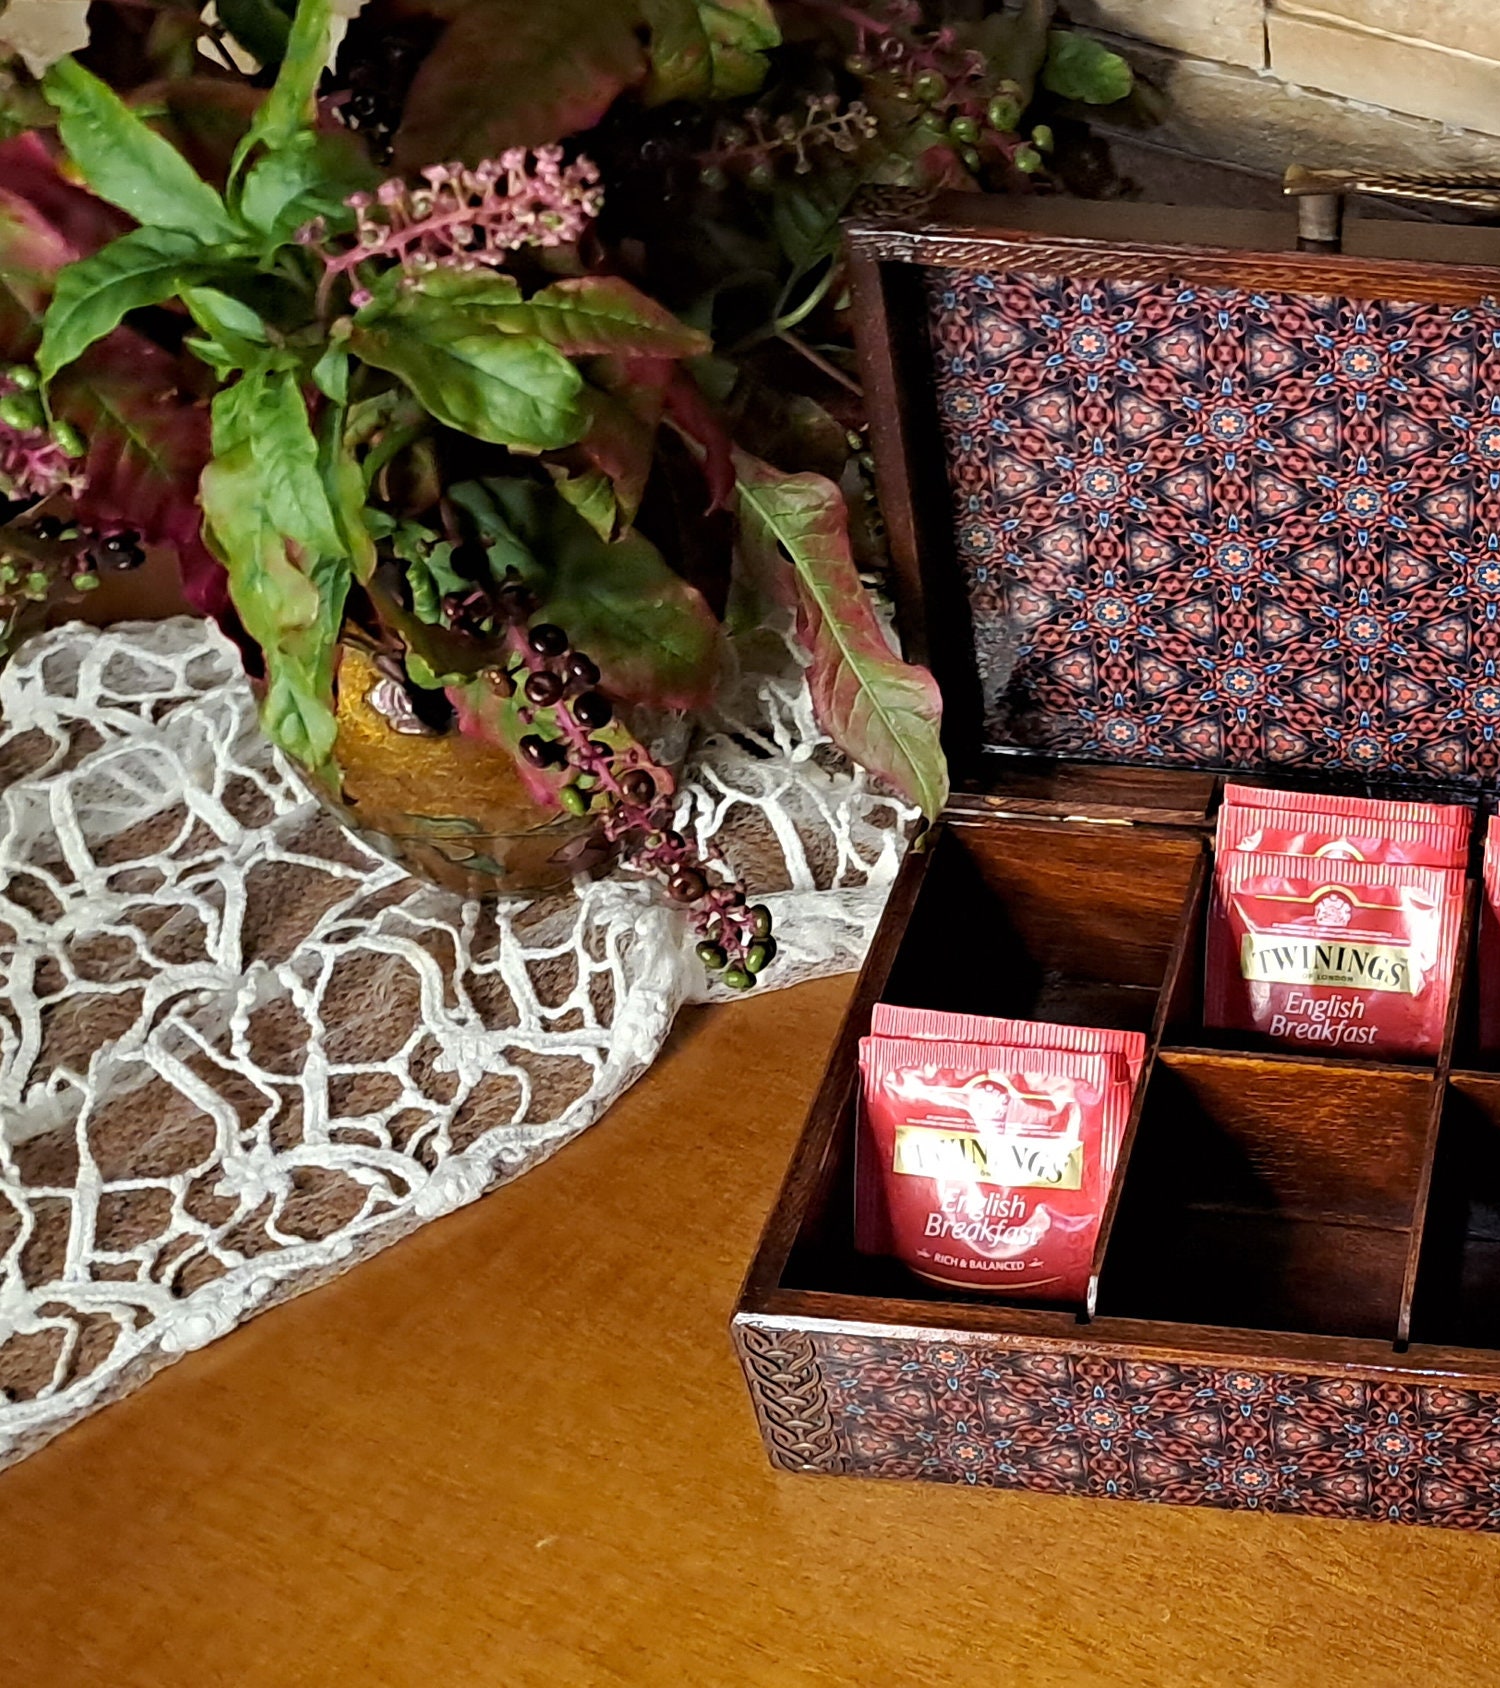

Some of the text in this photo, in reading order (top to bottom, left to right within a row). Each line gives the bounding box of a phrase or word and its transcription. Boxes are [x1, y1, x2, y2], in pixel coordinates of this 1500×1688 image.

[1252, 945, 1407, 987] TWININGS
[1285, 991, 1365, 1022] English
[1270, 1014, 1379, 1046] Breakfast
[941, 1187, 1026, 1221] English
[924, 1212, 1040, 1248] Breakfast
[934, 1252, 1025, 1271] RICH & BALANCED
